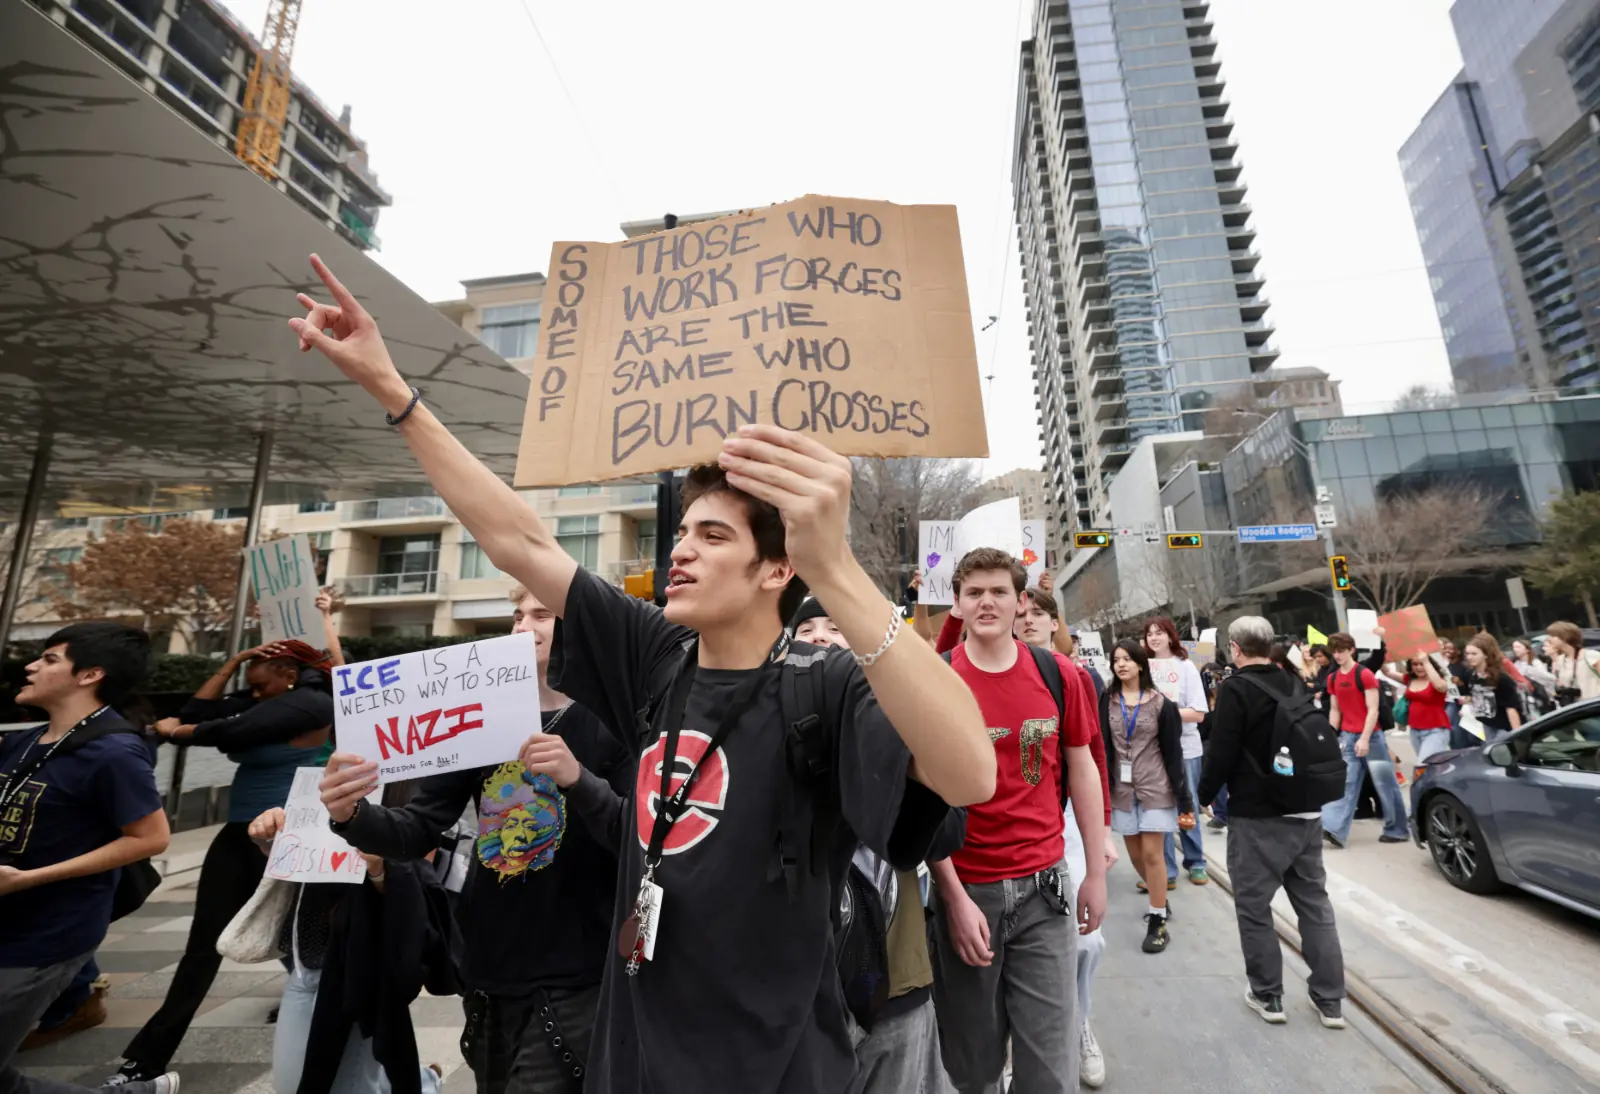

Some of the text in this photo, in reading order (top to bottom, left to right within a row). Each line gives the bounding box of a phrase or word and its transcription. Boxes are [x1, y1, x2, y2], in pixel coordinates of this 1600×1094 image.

[622, 206, 882, 275] THOSE WHO
[623, 254, 902, 321] WORK FORCES
[539, 244, 588, 422] SOME OF
[615, 302, 828, 360] ARE THE
[611, 337, 850, 396] SAME WHO
[612, 378, 930, 465] BURN CROSSES
[1241, 527, 1276, 537] Woodall
[1278, 526, 1313, 537] Rodgers
[337, 644, 482, 696] ICE IS A
[340, 665, 532, 716] WEIRD WAY TO SPELL
[374, 703, 484, 760] NAZI
